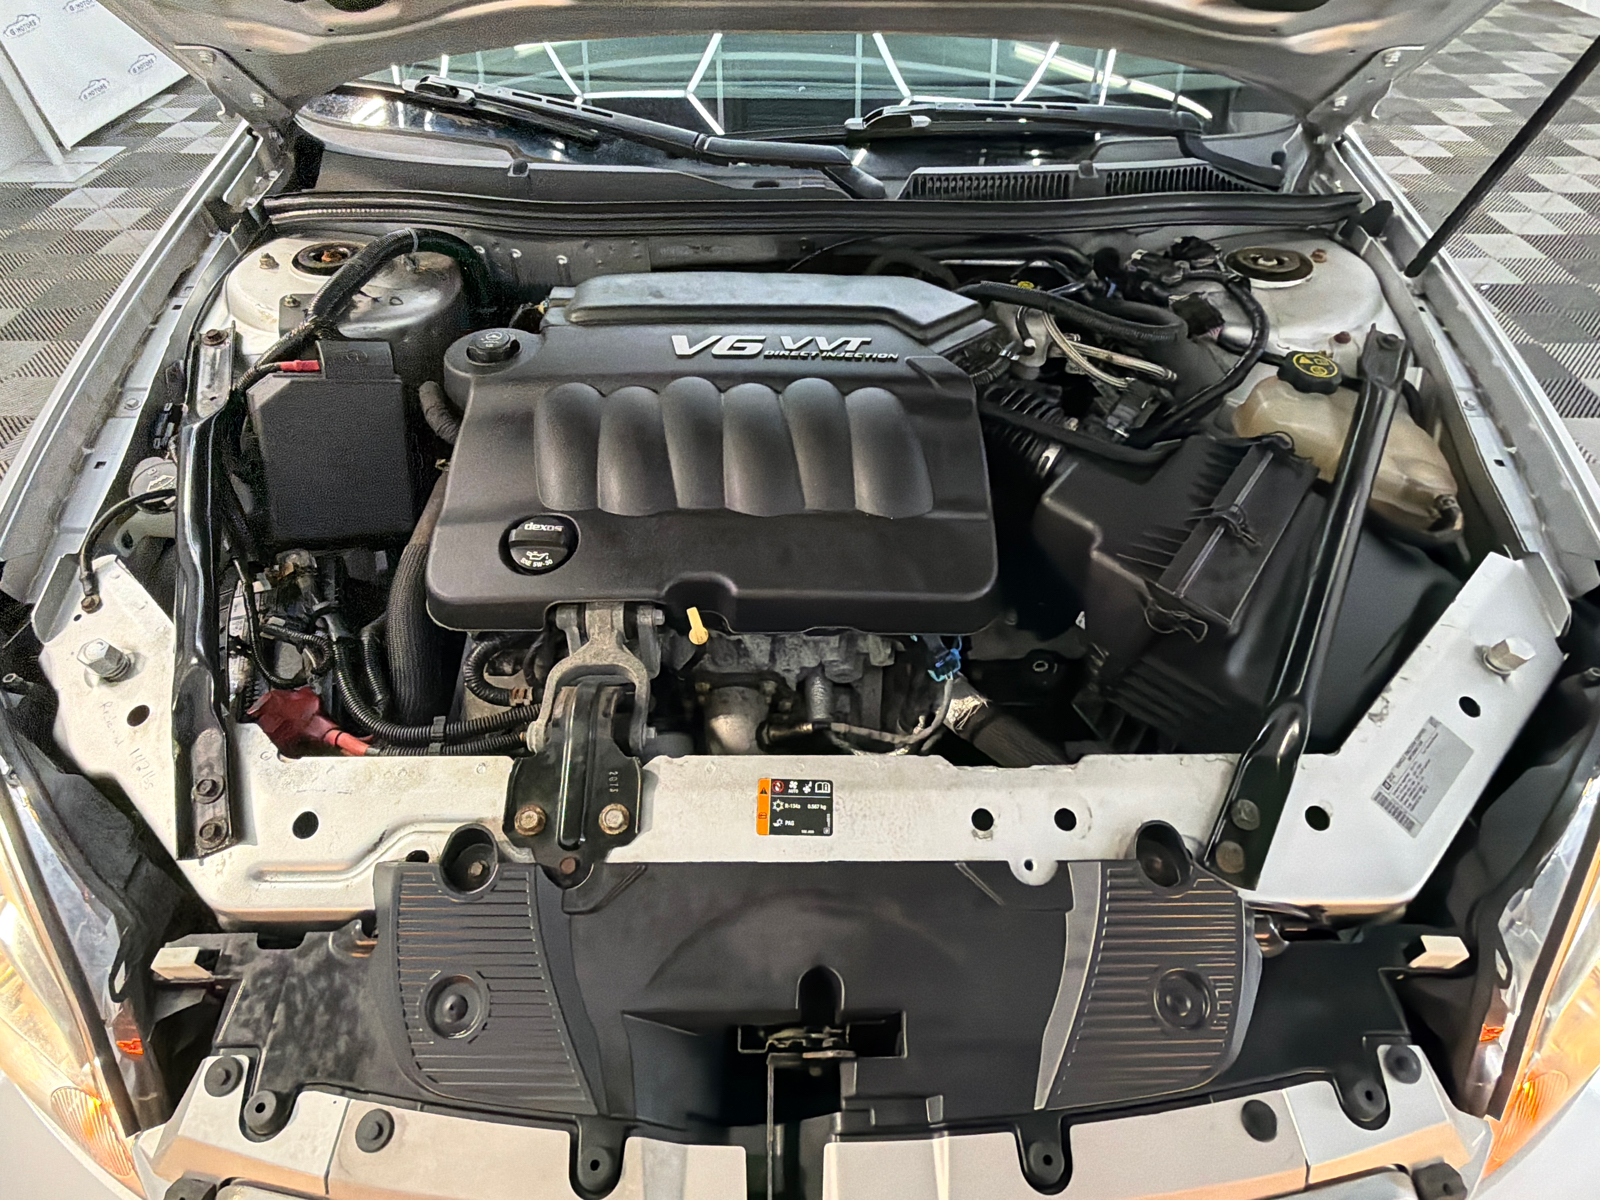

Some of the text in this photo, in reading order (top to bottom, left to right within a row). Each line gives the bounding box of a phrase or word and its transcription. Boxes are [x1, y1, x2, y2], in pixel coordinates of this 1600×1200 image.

[671, 334, 872, 357] V6 VVT
[763, 350, 899, 361] DIRECT INJECTION
[524, 522, 564, 532] dexos
